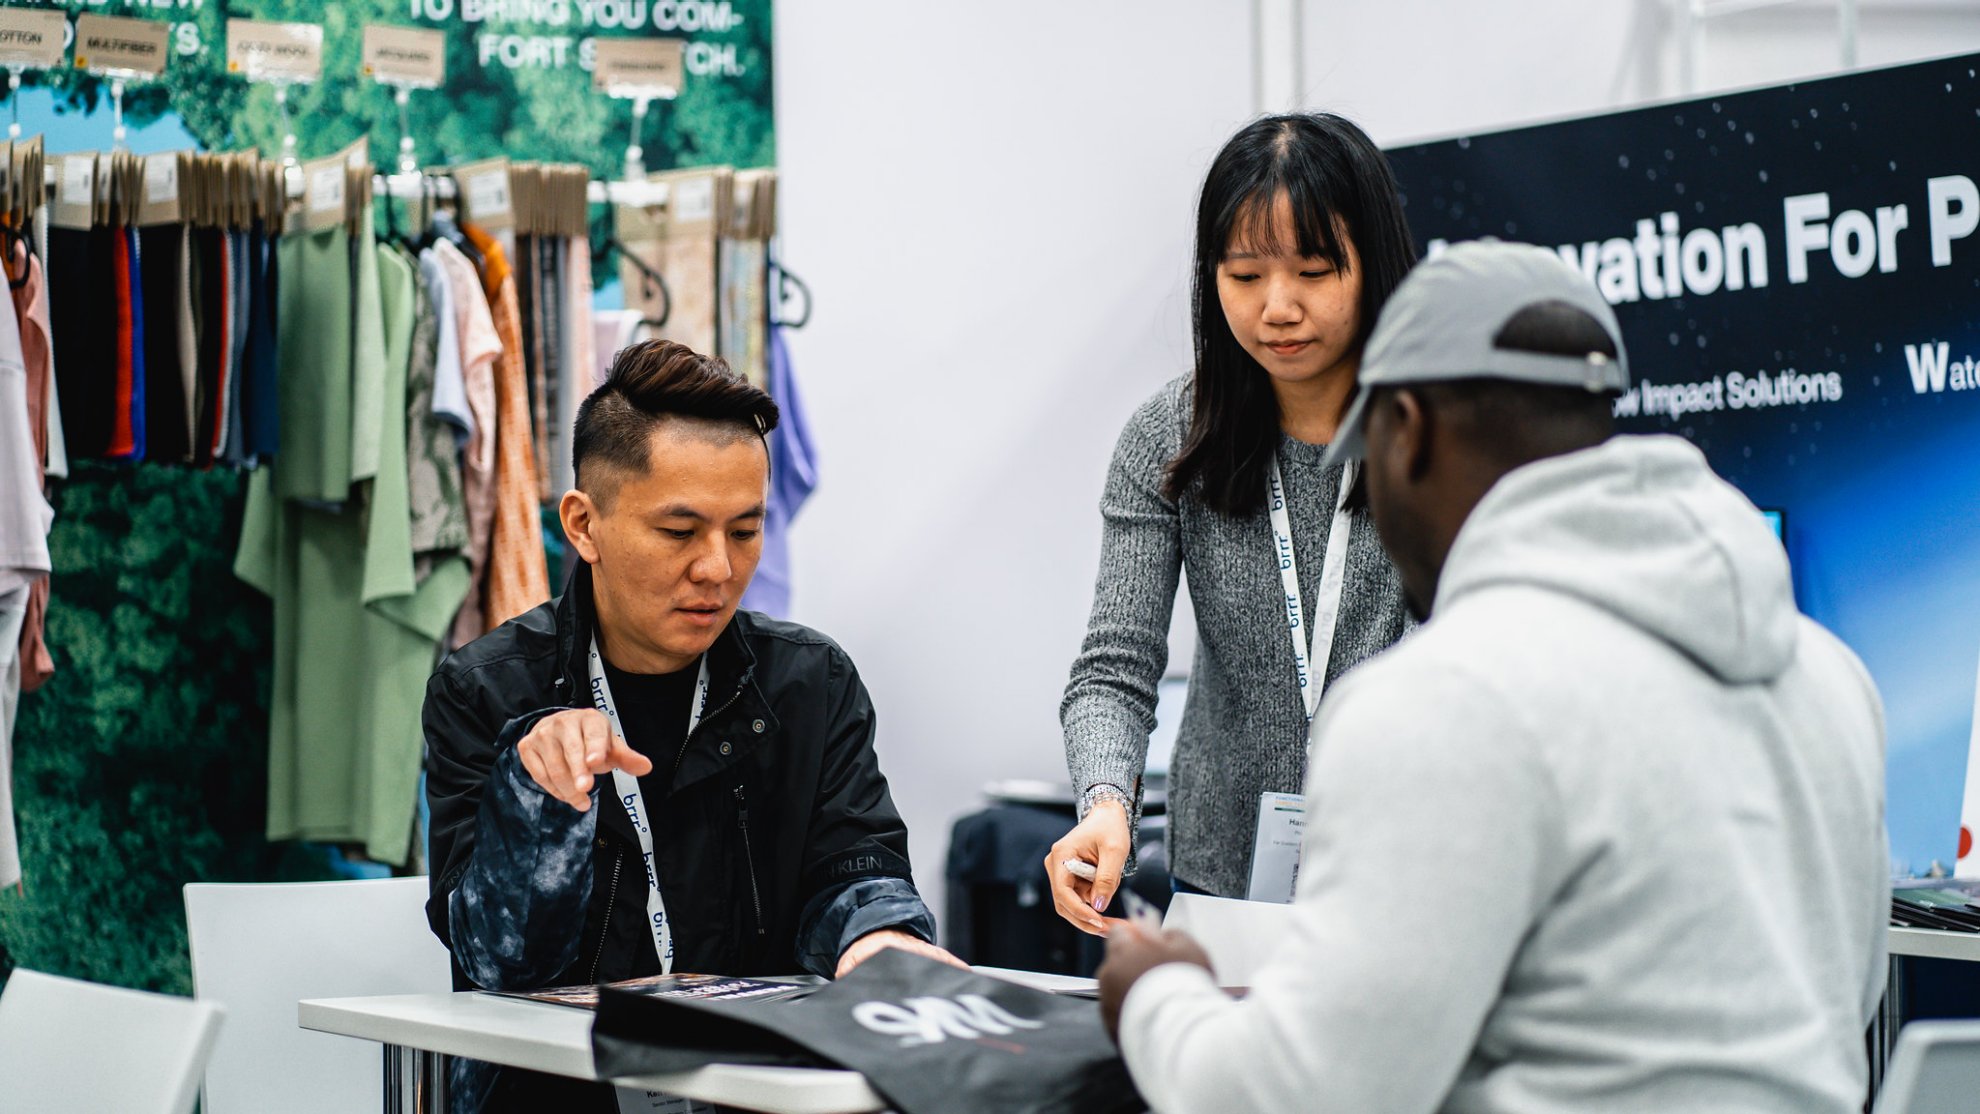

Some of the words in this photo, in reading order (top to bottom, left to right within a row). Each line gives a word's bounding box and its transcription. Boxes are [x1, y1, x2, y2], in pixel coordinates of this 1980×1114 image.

[573, 0, 647, 30] YOU
[0, 29, 42, 45] OTTON
[479, 33, 573, 70] FORT
[1784, 192, 1908, 284] For
[1641, 375, 1724, 421] Impact
[1725, 368, 1843, 410] Solutions
